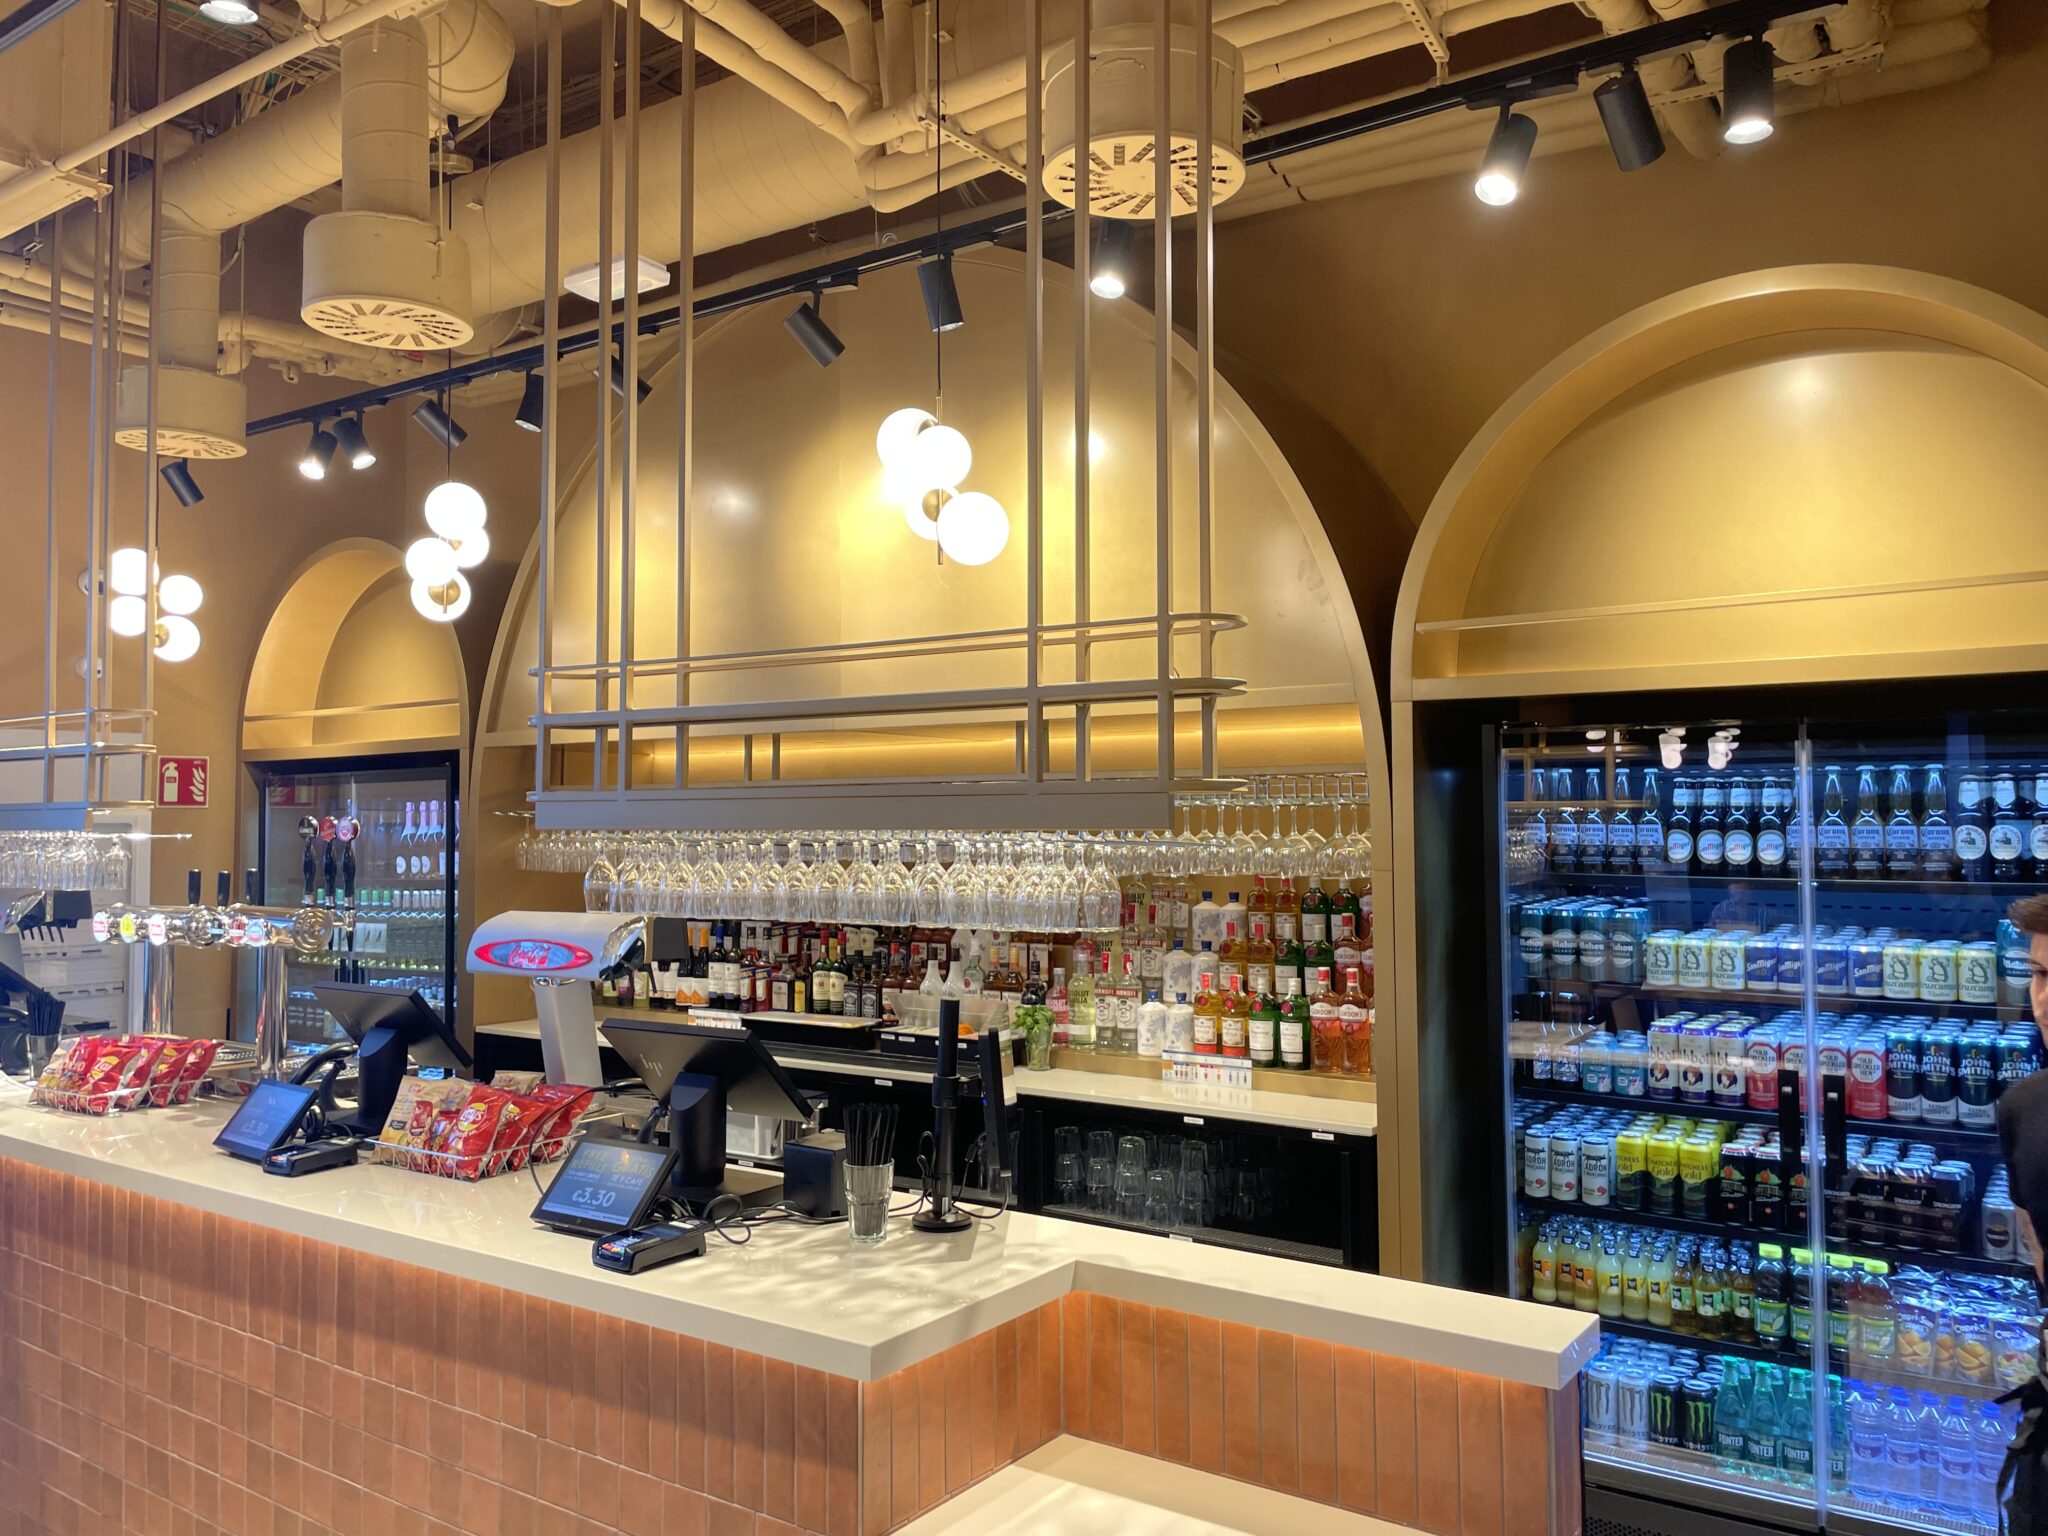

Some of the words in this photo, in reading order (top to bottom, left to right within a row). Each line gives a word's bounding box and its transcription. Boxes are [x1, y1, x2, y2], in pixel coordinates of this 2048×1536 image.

[1552, 825, 1576, 834] Corona
[1580, 825, 1605, 834] Corona
[1609, 826, 1634, 834] Corona
[1820, 828, 1846, 836] Corona
[1853, 828, 1880, 837] Corona
[1887, 828, 1915, 837] Corona
[1921, 829, 1950, 837] Corona
[1888, 1053, 1917, 1062] JOHN
[1922, 1055, 1952, 1066] JOHN
[1961, 1058, 1991, 1069] JOHN
[2001, 1061, 2032, 1072] JOHN
[1651, 1165, 1675, 1177] Gold
[1719, 1433, 1744, 1447] FONTER
[1784, 1446, 1810, 1461] FONTER
